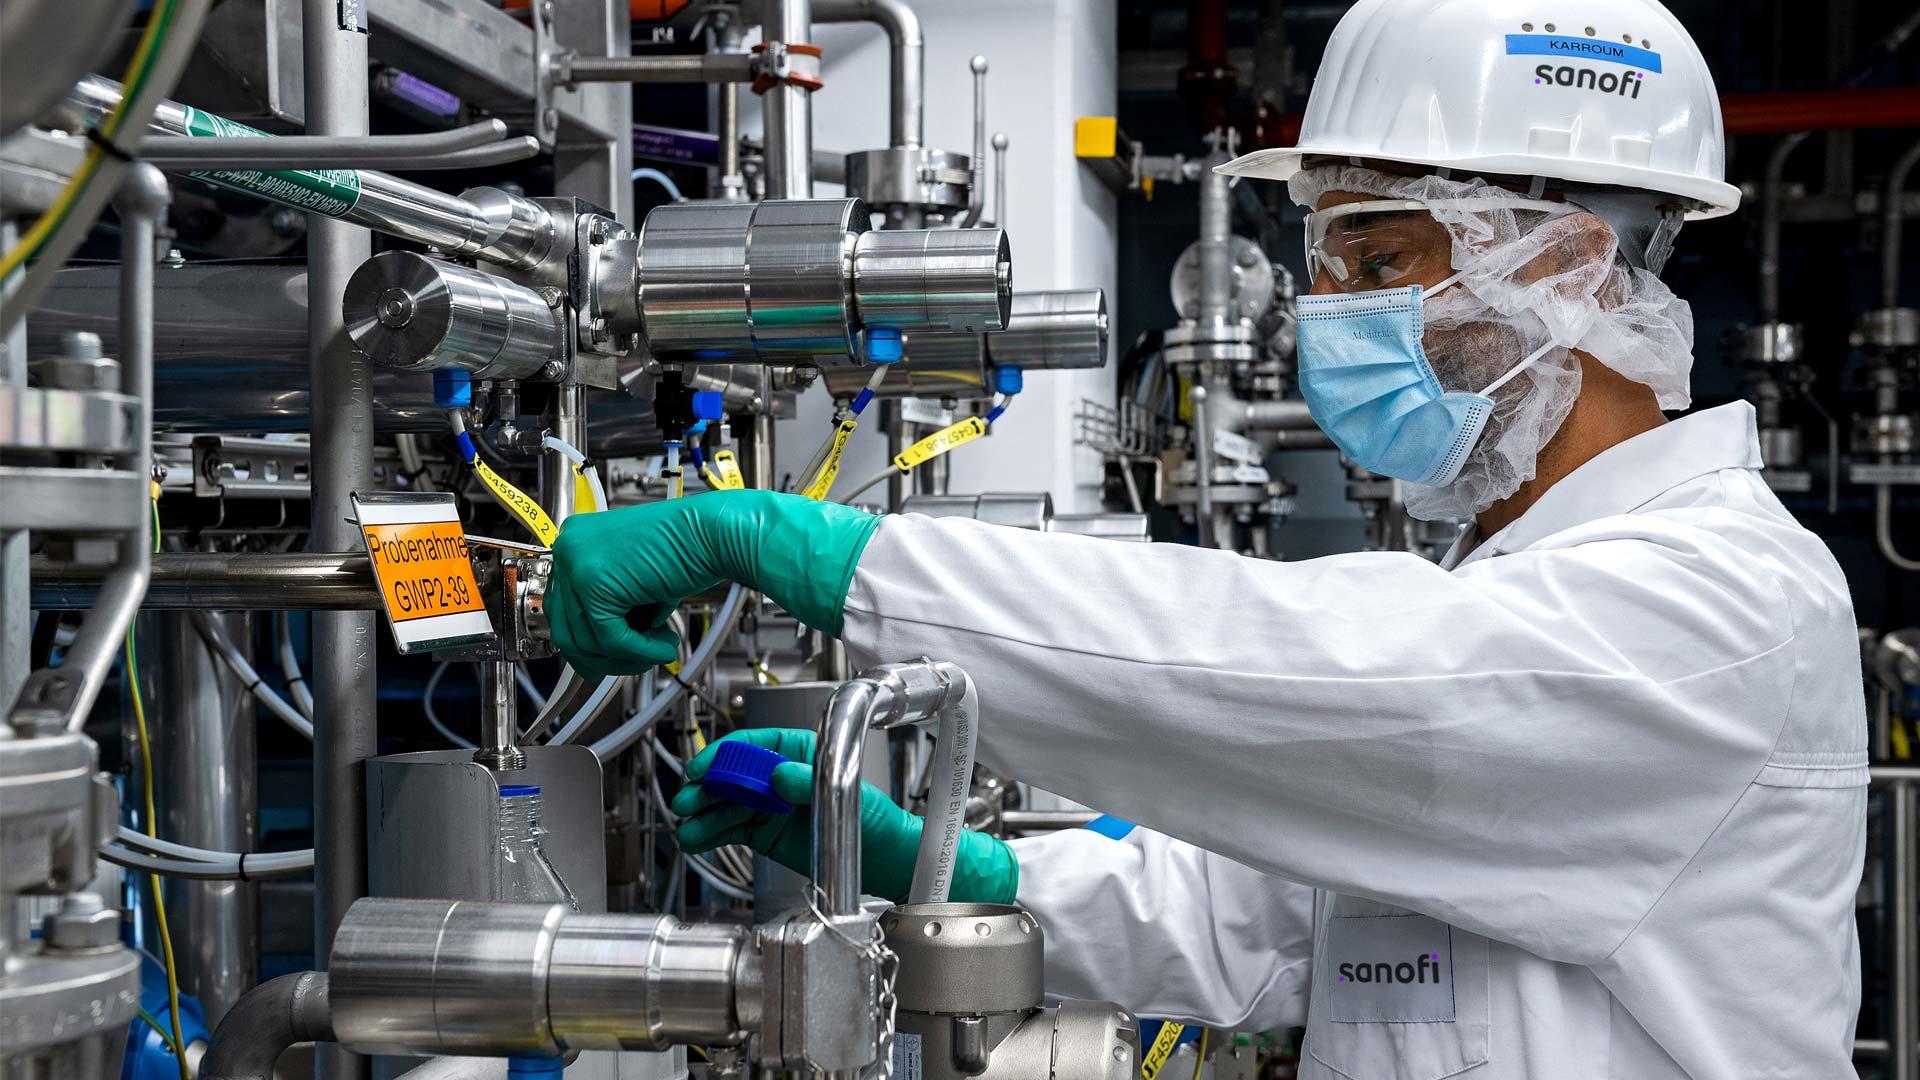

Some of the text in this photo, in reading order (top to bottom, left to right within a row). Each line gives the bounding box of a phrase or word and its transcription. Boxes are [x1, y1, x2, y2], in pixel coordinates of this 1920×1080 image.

[1550, 40, 1625, 58] KARROUM
[1534, 64, 1644, 100] sanofi
[368, 530, 469, 566] Probenahme
[394, 576, 470, 612] GWP2-39
[948, 801, 961, 815] EN
[936, 818, 957, 877] 16643:2016
[1338, 951, 1440, 984] sanofi
